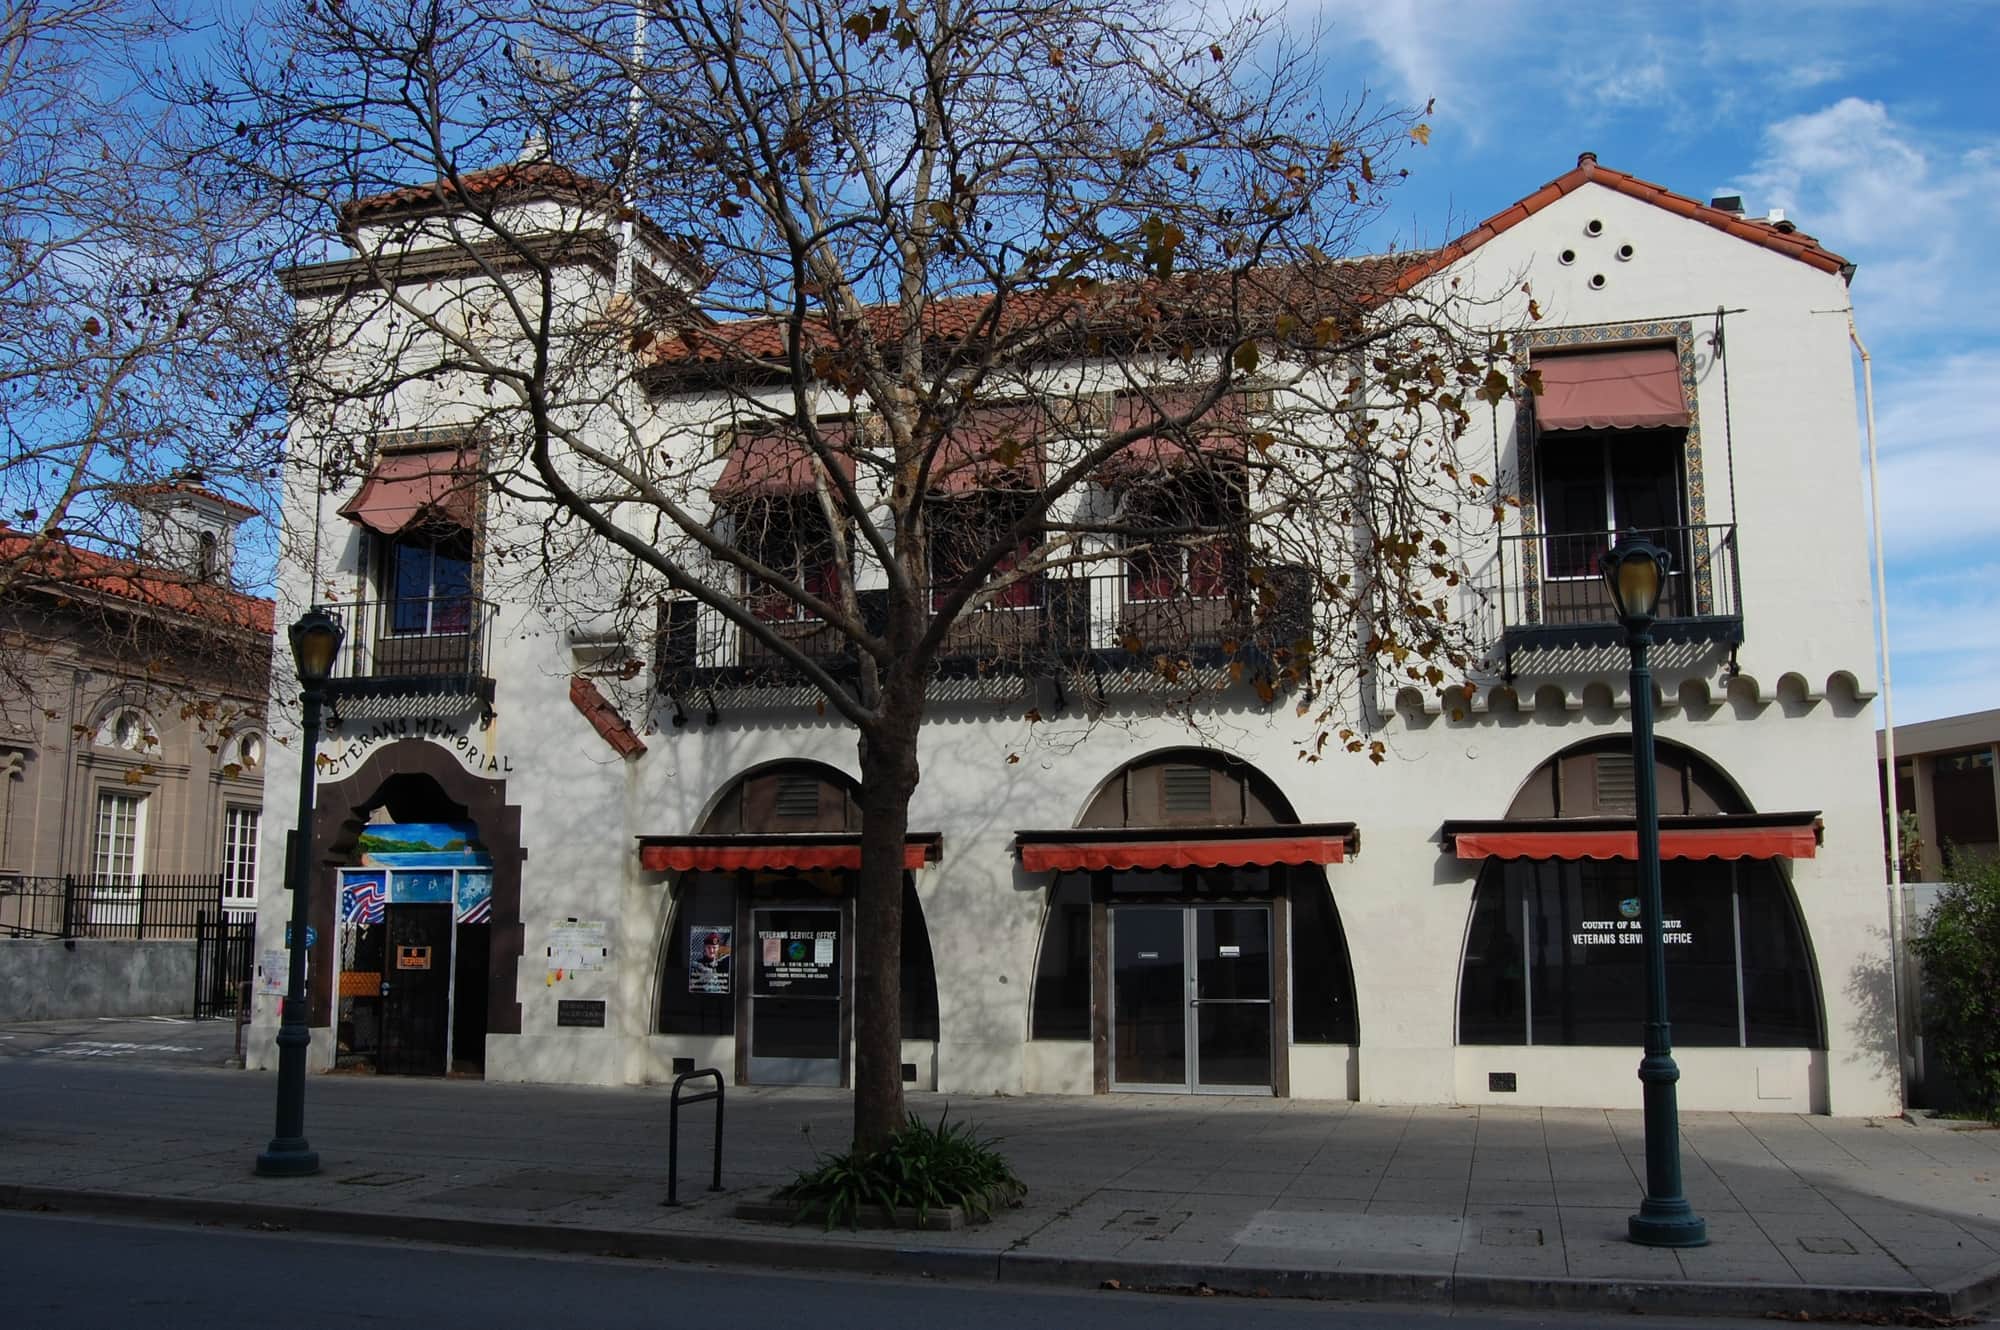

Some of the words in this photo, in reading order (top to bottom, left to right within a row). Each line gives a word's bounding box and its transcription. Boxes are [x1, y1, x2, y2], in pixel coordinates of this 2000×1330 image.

[316, 717, 407, 776] VETERANS
[415, 717, 513, 772] MEMORIAL
[1582, 921, 1614, 929] COUNTY
[1616, 921, 1628, 929] OF
[790, 931, 814, 940] SERVICE
[816, 931, 836, 940] OFFICE
[1572, 933, 1616, 945] VETERANS
[1662, 932, 1692, 944] OFFICE
